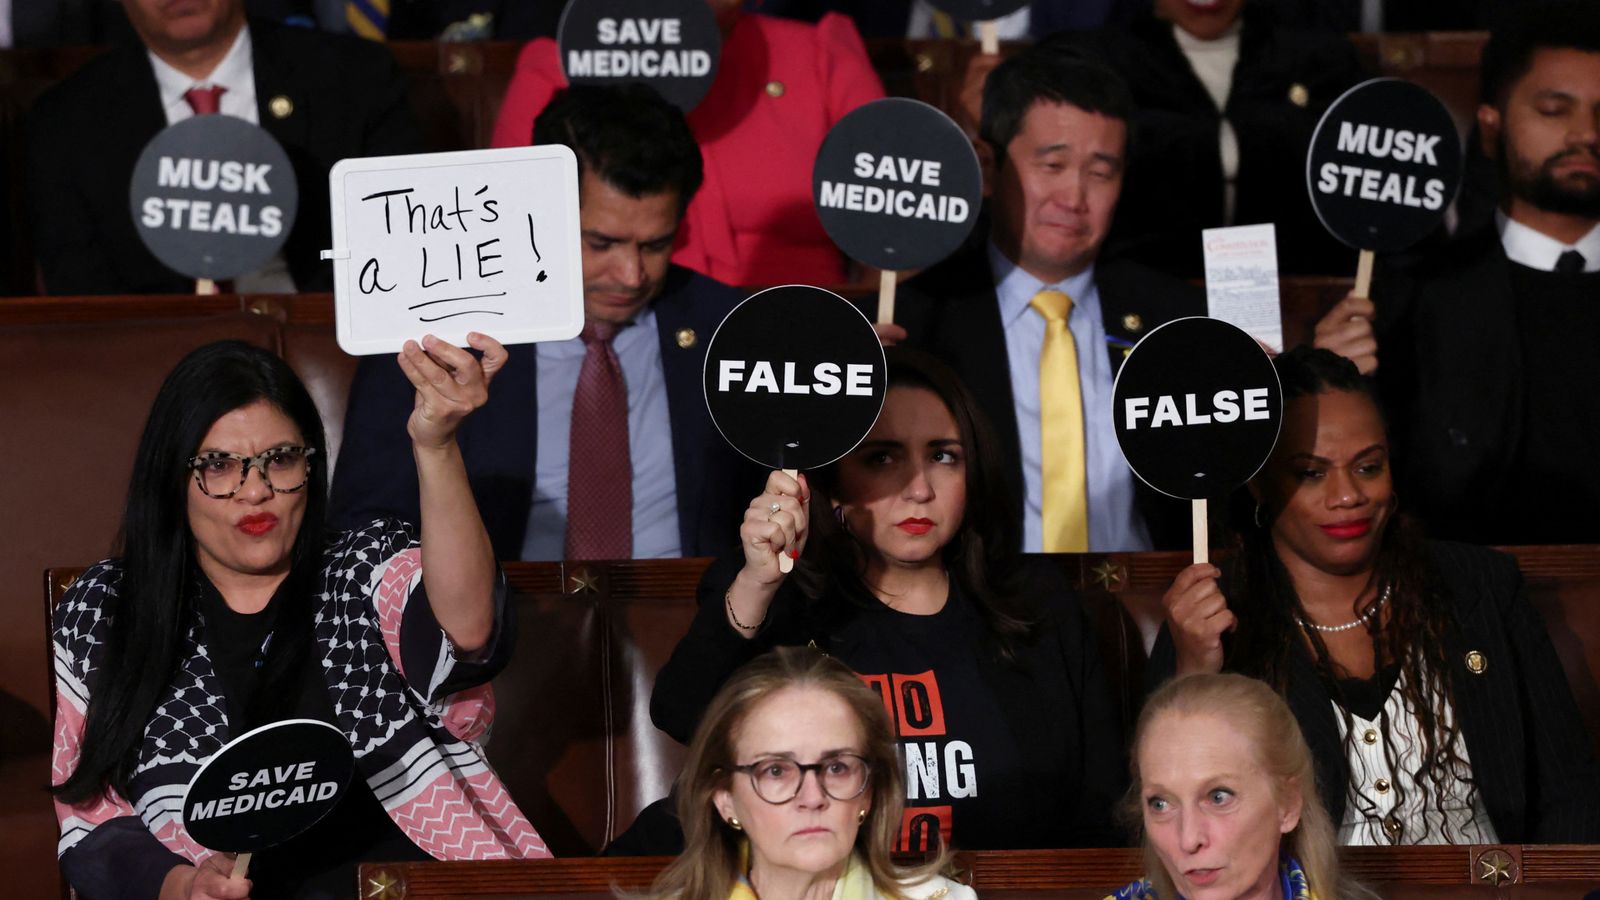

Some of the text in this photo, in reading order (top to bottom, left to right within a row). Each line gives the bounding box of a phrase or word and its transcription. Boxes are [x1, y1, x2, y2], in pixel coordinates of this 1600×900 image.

[598, 18, 681, 44] SAVE
[568, 49, 711, 78] MEDICAID
[1337, 121, 1441, 166] MUSK
[158, 156, 271, 194] MUSK
[854, 152, 941, 187] SAVE
[1317, 162, 1445, 210] STEALS
[142, 197, 282, 237] STEALS
[820, 180, 969, 223] MEDICAID
[358, 257, 397, 295] a
[718, 359, 874, 397] FALSE
[1124, 387, 1270, 430] FALSE
[228, 760, 317, 791] SAVE
[189, 781, 338, 822] MEDICAID
